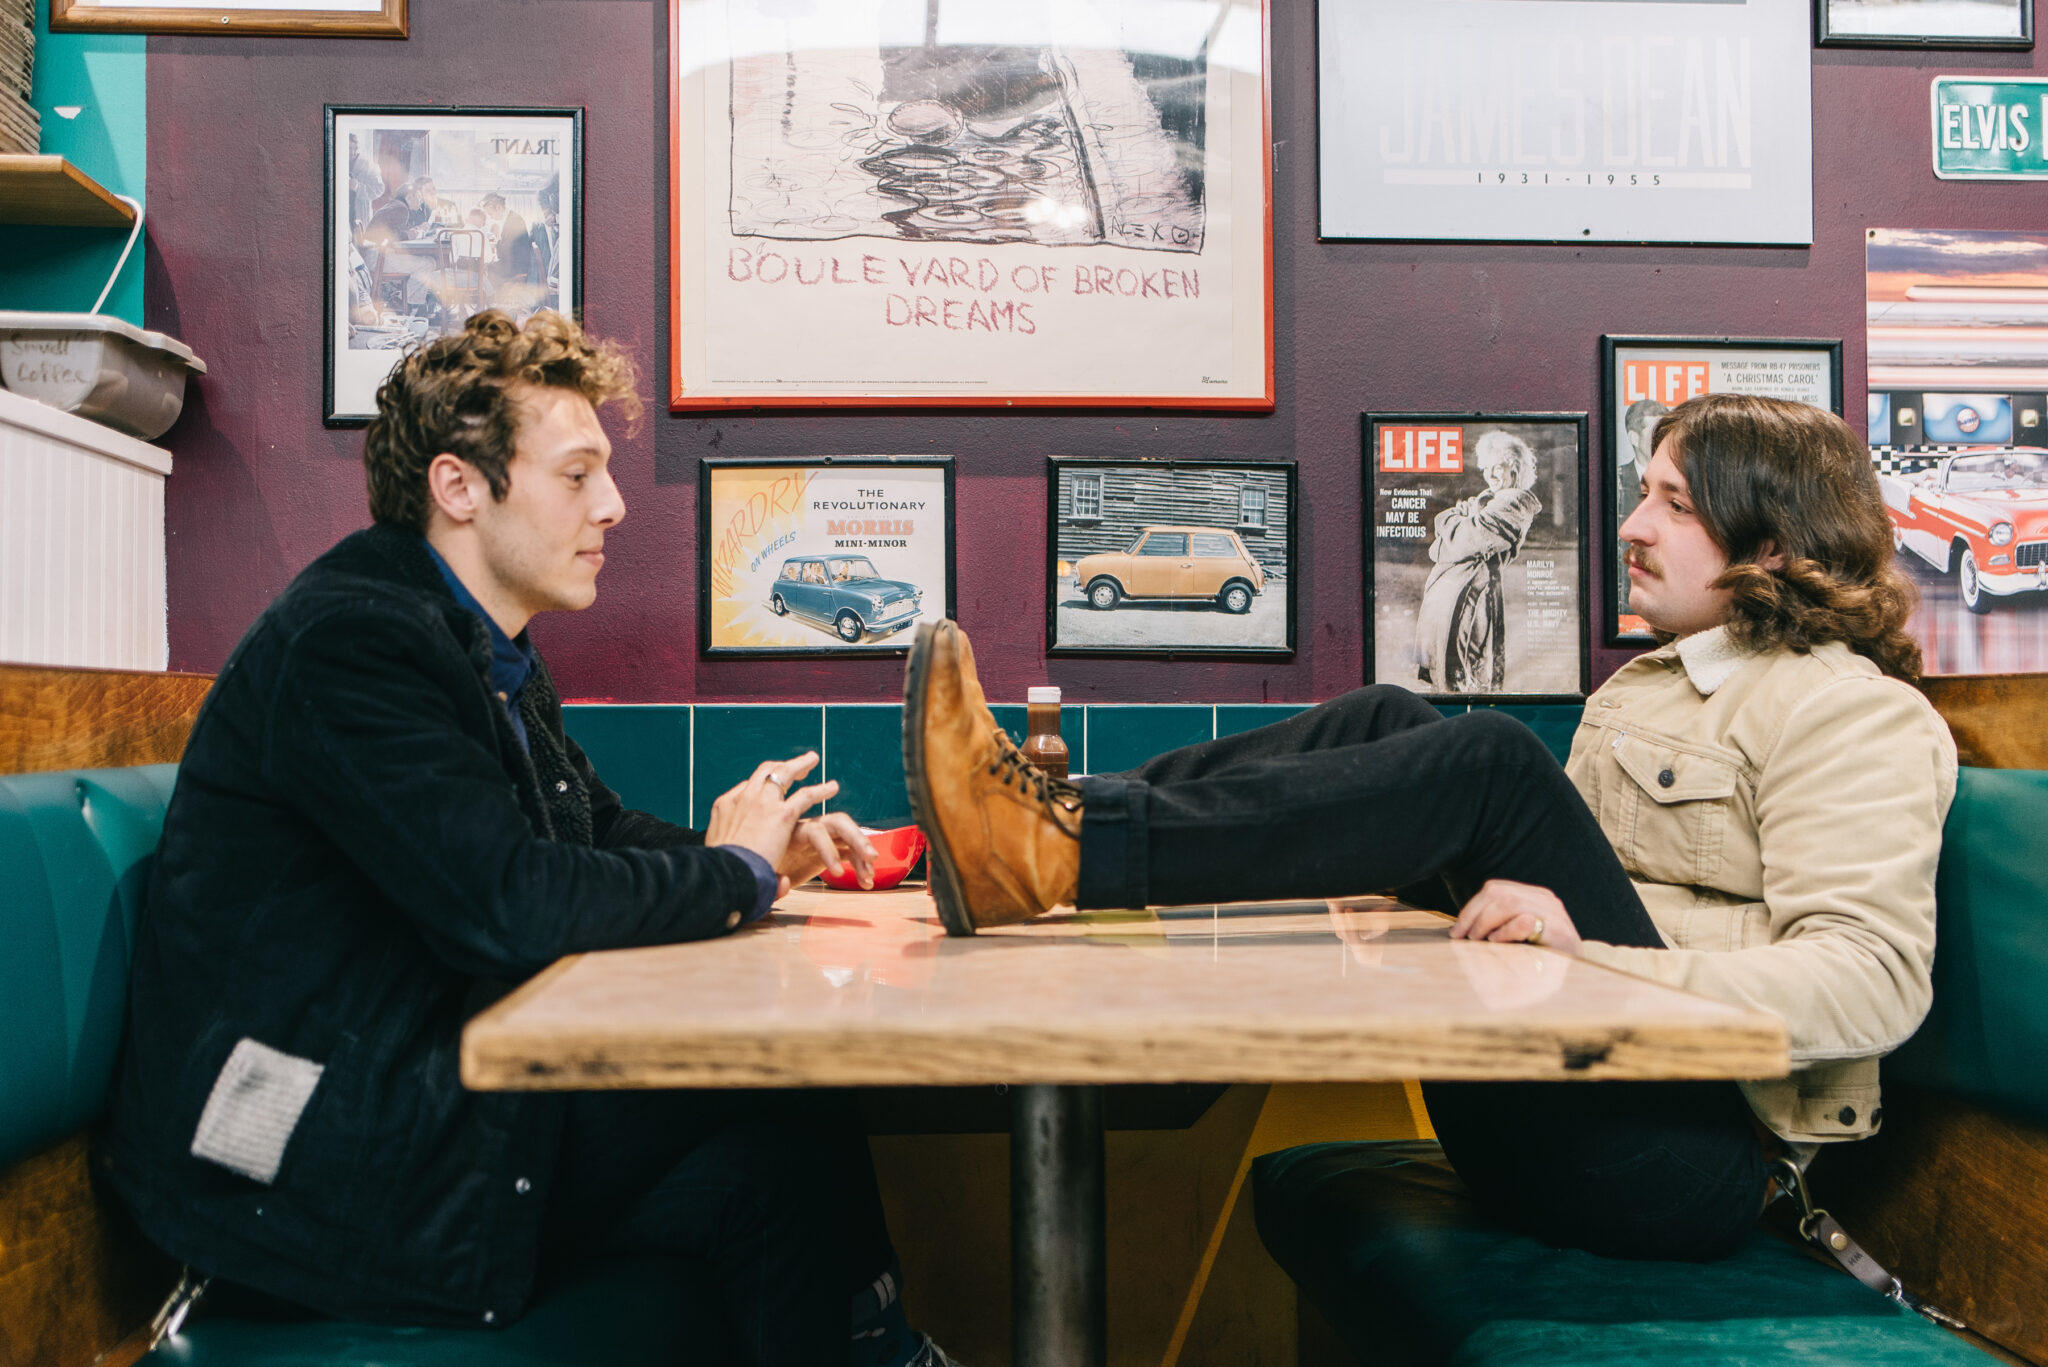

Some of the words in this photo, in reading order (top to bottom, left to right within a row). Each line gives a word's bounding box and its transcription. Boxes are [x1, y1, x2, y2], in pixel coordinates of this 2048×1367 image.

[1379, 33, 1585, 165] JAMES
[1601, 34, 1751, 168] DEAN
[1942, 104, 2029, 152] ELVIS
[727, 247, 999, 293] BOULEVARD
[1011, 264, 1060, 294] OF
[1074, 264, 1200, 299] BROKEN
[886, 293, 1036, 335] DREAMS
[1721, 362, 1748, 370] MESSAGE
[1750, 362, 1767, 370] FROM
[1788, 363, 1820, 372] PRISONERS
[1627, 365, 1705, 402] LIFE
[1736, 373, 1784, 385] CHRISTMAS
[1384, 431, 1460, 469] LIFE
[857, 488, 885, 498] THE
[1393, 488, 1419, 496] Evidence
[1420, 488, 1433, 496] That
[813, 501, 926, 511] REVOLUTIONARY
[1391, 498, 1427, 510] CANCER
[1385, 512, 1405, 524] MAY
[1407, 512, 1420, 524] BE
[827, 519, 914, 536] MORRIS
[1376, 525, 1427, 538] INFECTIOUS
[710, 471, 819, 599] WIZARDRY
[835, 539, 908, 548] MINI-MINOR
[750, 556, 761, 574] ON
[761, 530, 797, 560] WHEELS
[1526, 560, 1555, 569] MARILYN
[1526, 570, 1555, 579] MONROE
[1527, 609, 1540, 618] THE
